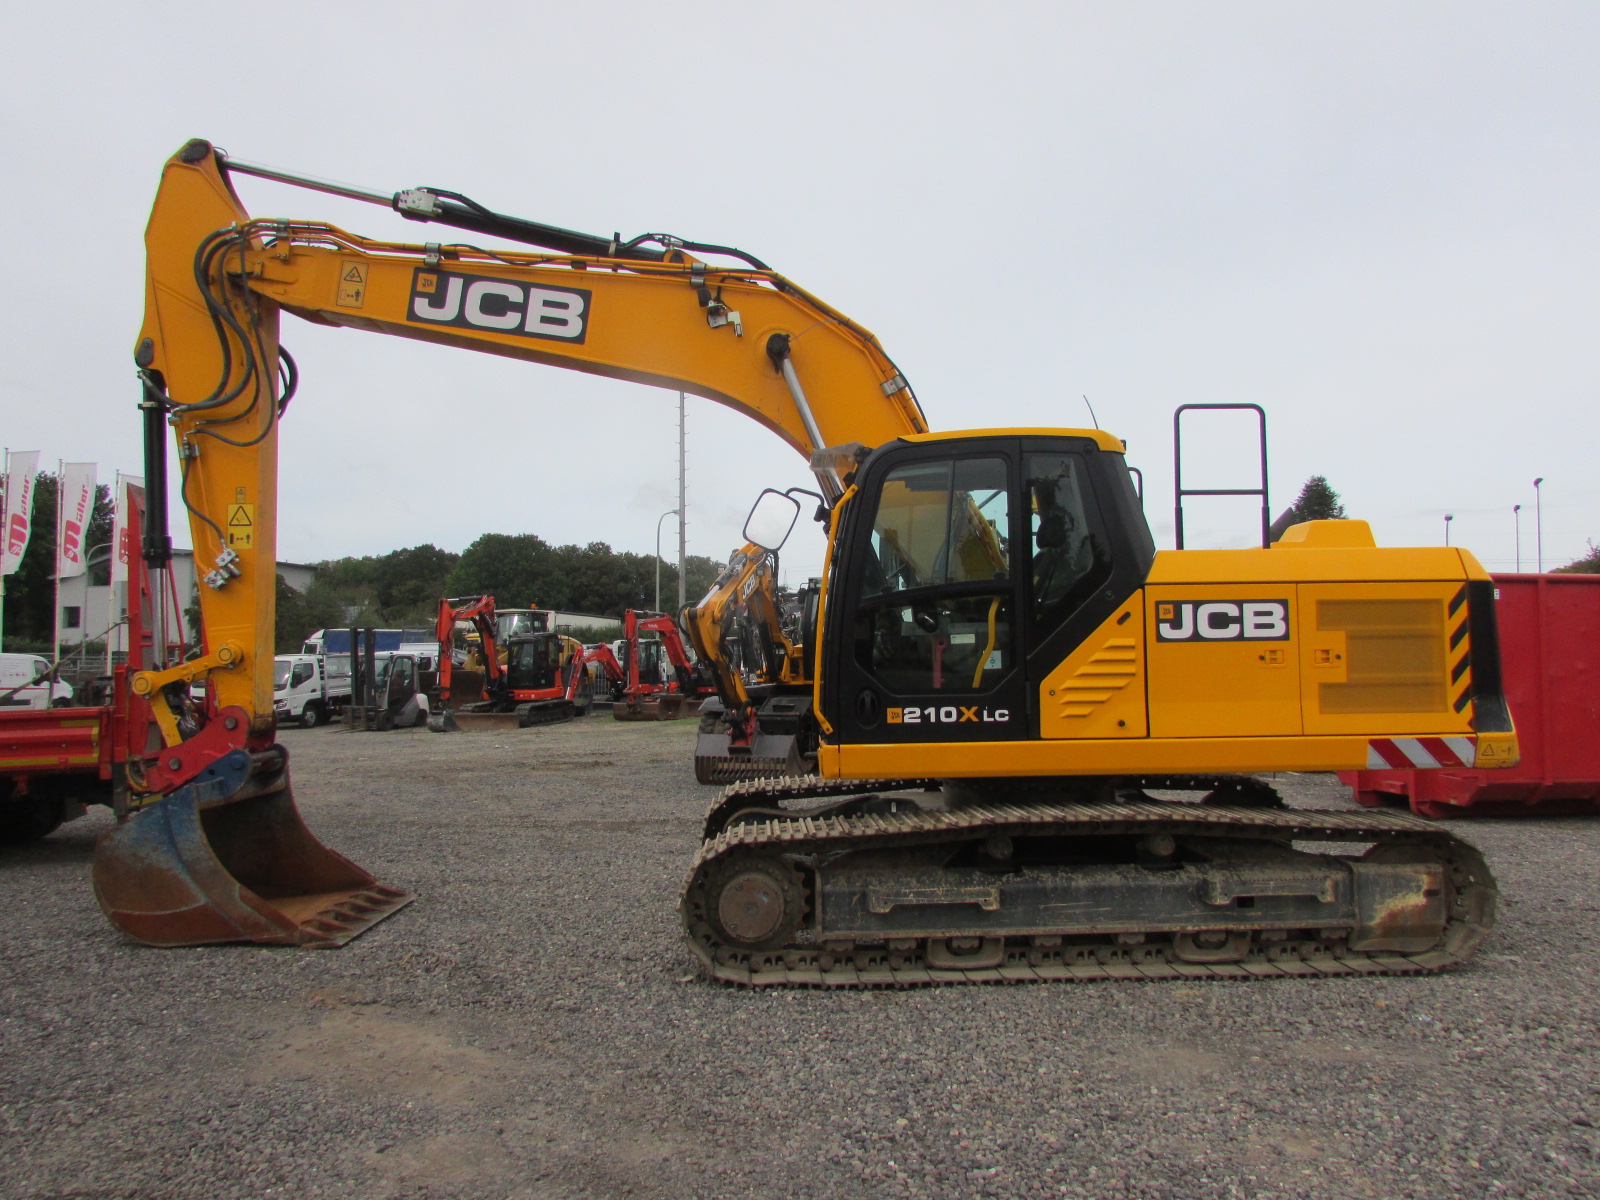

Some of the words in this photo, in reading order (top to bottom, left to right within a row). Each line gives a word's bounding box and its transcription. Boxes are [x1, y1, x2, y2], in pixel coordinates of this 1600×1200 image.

[413, 276, 585, 338] JCB
[742, 573, 756, 600] JCB
[1158, 602, 1287, 639] JCB
